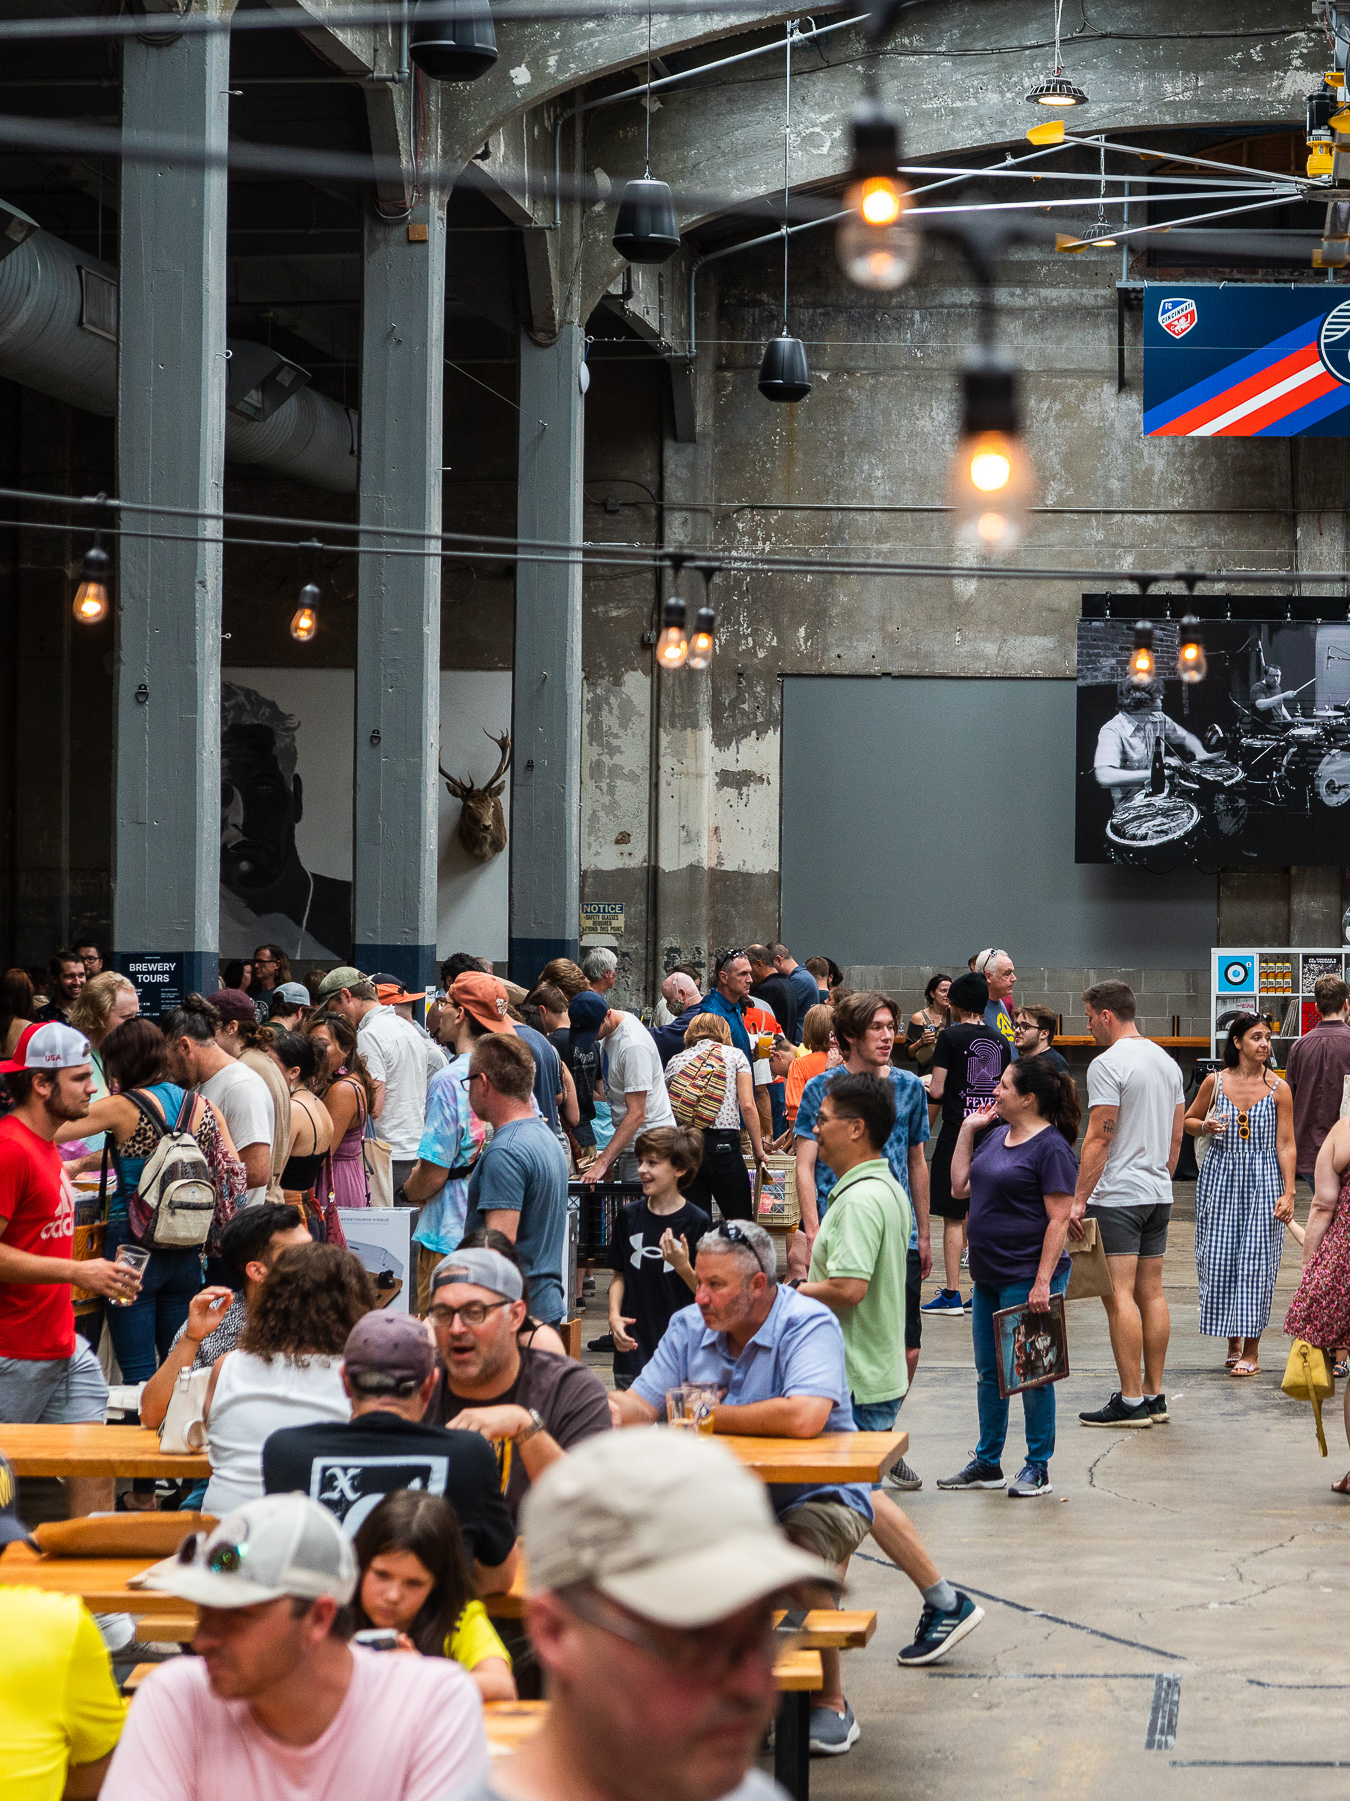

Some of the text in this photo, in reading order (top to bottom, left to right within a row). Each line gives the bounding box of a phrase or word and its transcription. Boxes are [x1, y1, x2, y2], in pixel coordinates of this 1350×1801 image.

[1161, 302, 1193, 324] CINCINNATI
[583, 904, 622, 913] NOTICE
[129, 962, 177, 972] BREWERY
[136, 974, 170, 983] TOURS
[45, 1054, 62, 1062] USA
[966, 1096, 996, 1108] FEVE
